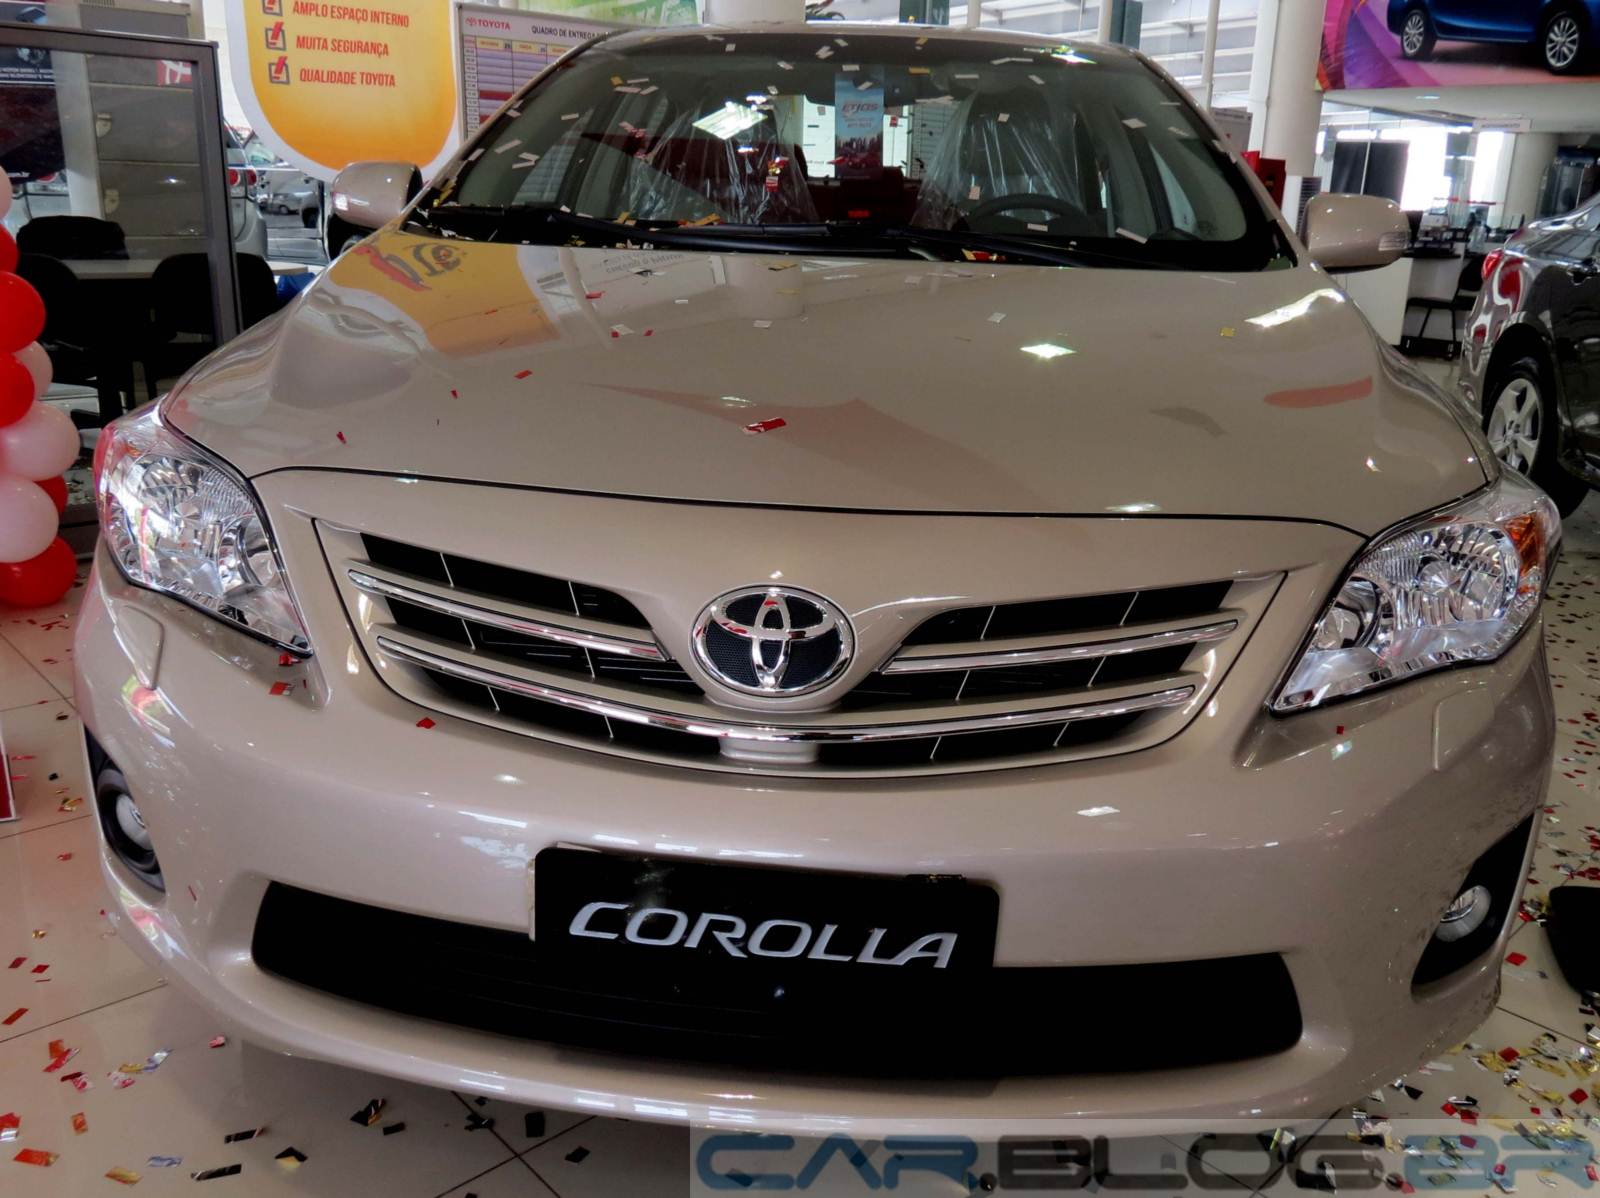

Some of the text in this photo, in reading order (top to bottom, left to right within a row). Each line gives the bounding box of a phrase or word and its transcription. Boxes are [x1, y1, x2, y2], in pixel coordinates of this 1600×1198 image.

[293, 1, 410, 28] AMPLO ESPAÇO INTERNO
[477, 19, 510, 30] TOYOTA
[531, 25, 558, 37] QUADRO
[559, 28, 566, 37] DE
[296, 35, 389, 58] MUITA SEGURANÇA
[300, 68, 396, 88] QUALIDADE TOYOTA
[568, 901, 958, 969] COROLLA
